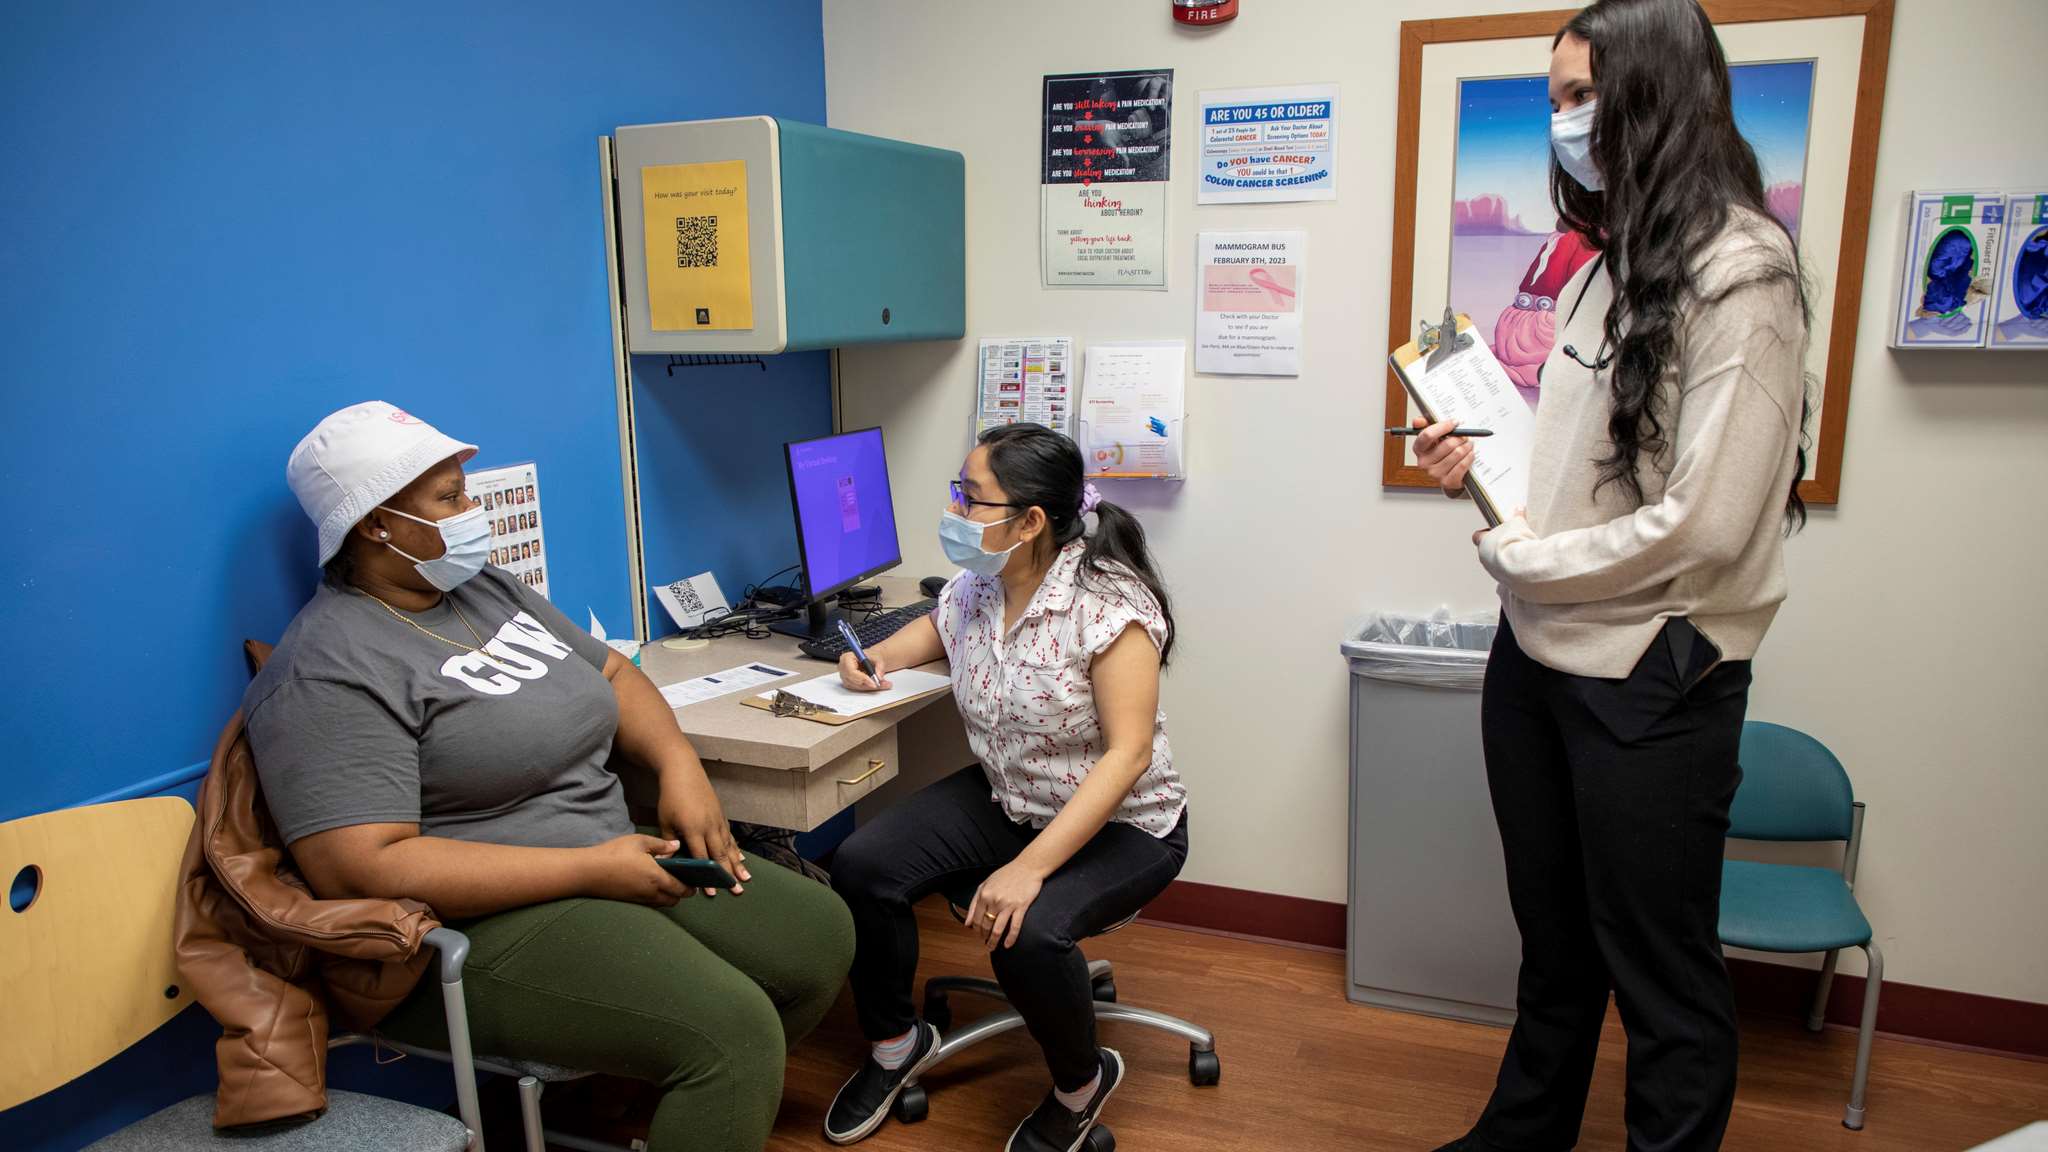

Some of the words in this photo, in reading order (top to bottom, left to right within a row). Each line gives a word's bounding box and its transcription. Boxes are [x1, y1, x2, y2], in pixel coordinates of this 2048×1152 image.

[1188, 9, 1217, 20] FIRE
[1063, 102, 1074, 110] YOU
[1133, 98, 1165, 107] MEDICATION?
[1210, 110, 1230, 122] ARE
[1232, 108, 1252, 120] YOU
[1254, 108, 1268, 119] 45
[1270, 106, 1285, 118] OR
[1287, 104, 1326, 117] OLDER?
[1063, 124, 1073, 132] YOU
[1117, 121, 1149, 130] MEDICATION?
[1291, 132, 1308, 140] Options
[1063, 148, 1073, 156] YOU
[1116, 146, 1127, 154] PAIN
[1128, 145, 1160, 154] MEDICATION?
[1230, 157, 1248, 166] YOU
[1249, 155, 1271, 164] have
[1272, 155, 1315, 164] CANCER?
[1062, 169, 1072, 177] YOU
[1104, 168, 1136, 177] MEDICATION?
[1236, 168, 1251, 176] YOU
[1276, 167, 1288, 175] that
[1205, 174, 1235, 187] COLON
[1236, 179, 1273, 188] CANCER
[1275, 169, 1328, 187] SCREENING
[654, 191, 669, 199] How
[684, 190, 698, 199] your
[700, 188, 713, 197] visit
[715, 186, 738, 197] today?
[1091, 189, 1102, 197] YOU
[1084, 197, 1121, 212] thinking
[1119, 208, 1144, 216] HEROIN?
[1951, 205, 1970, 217] L
[1983, 227, 1996, 265] FitGuard
[1250, 257, 1267, 265] 8TH,
